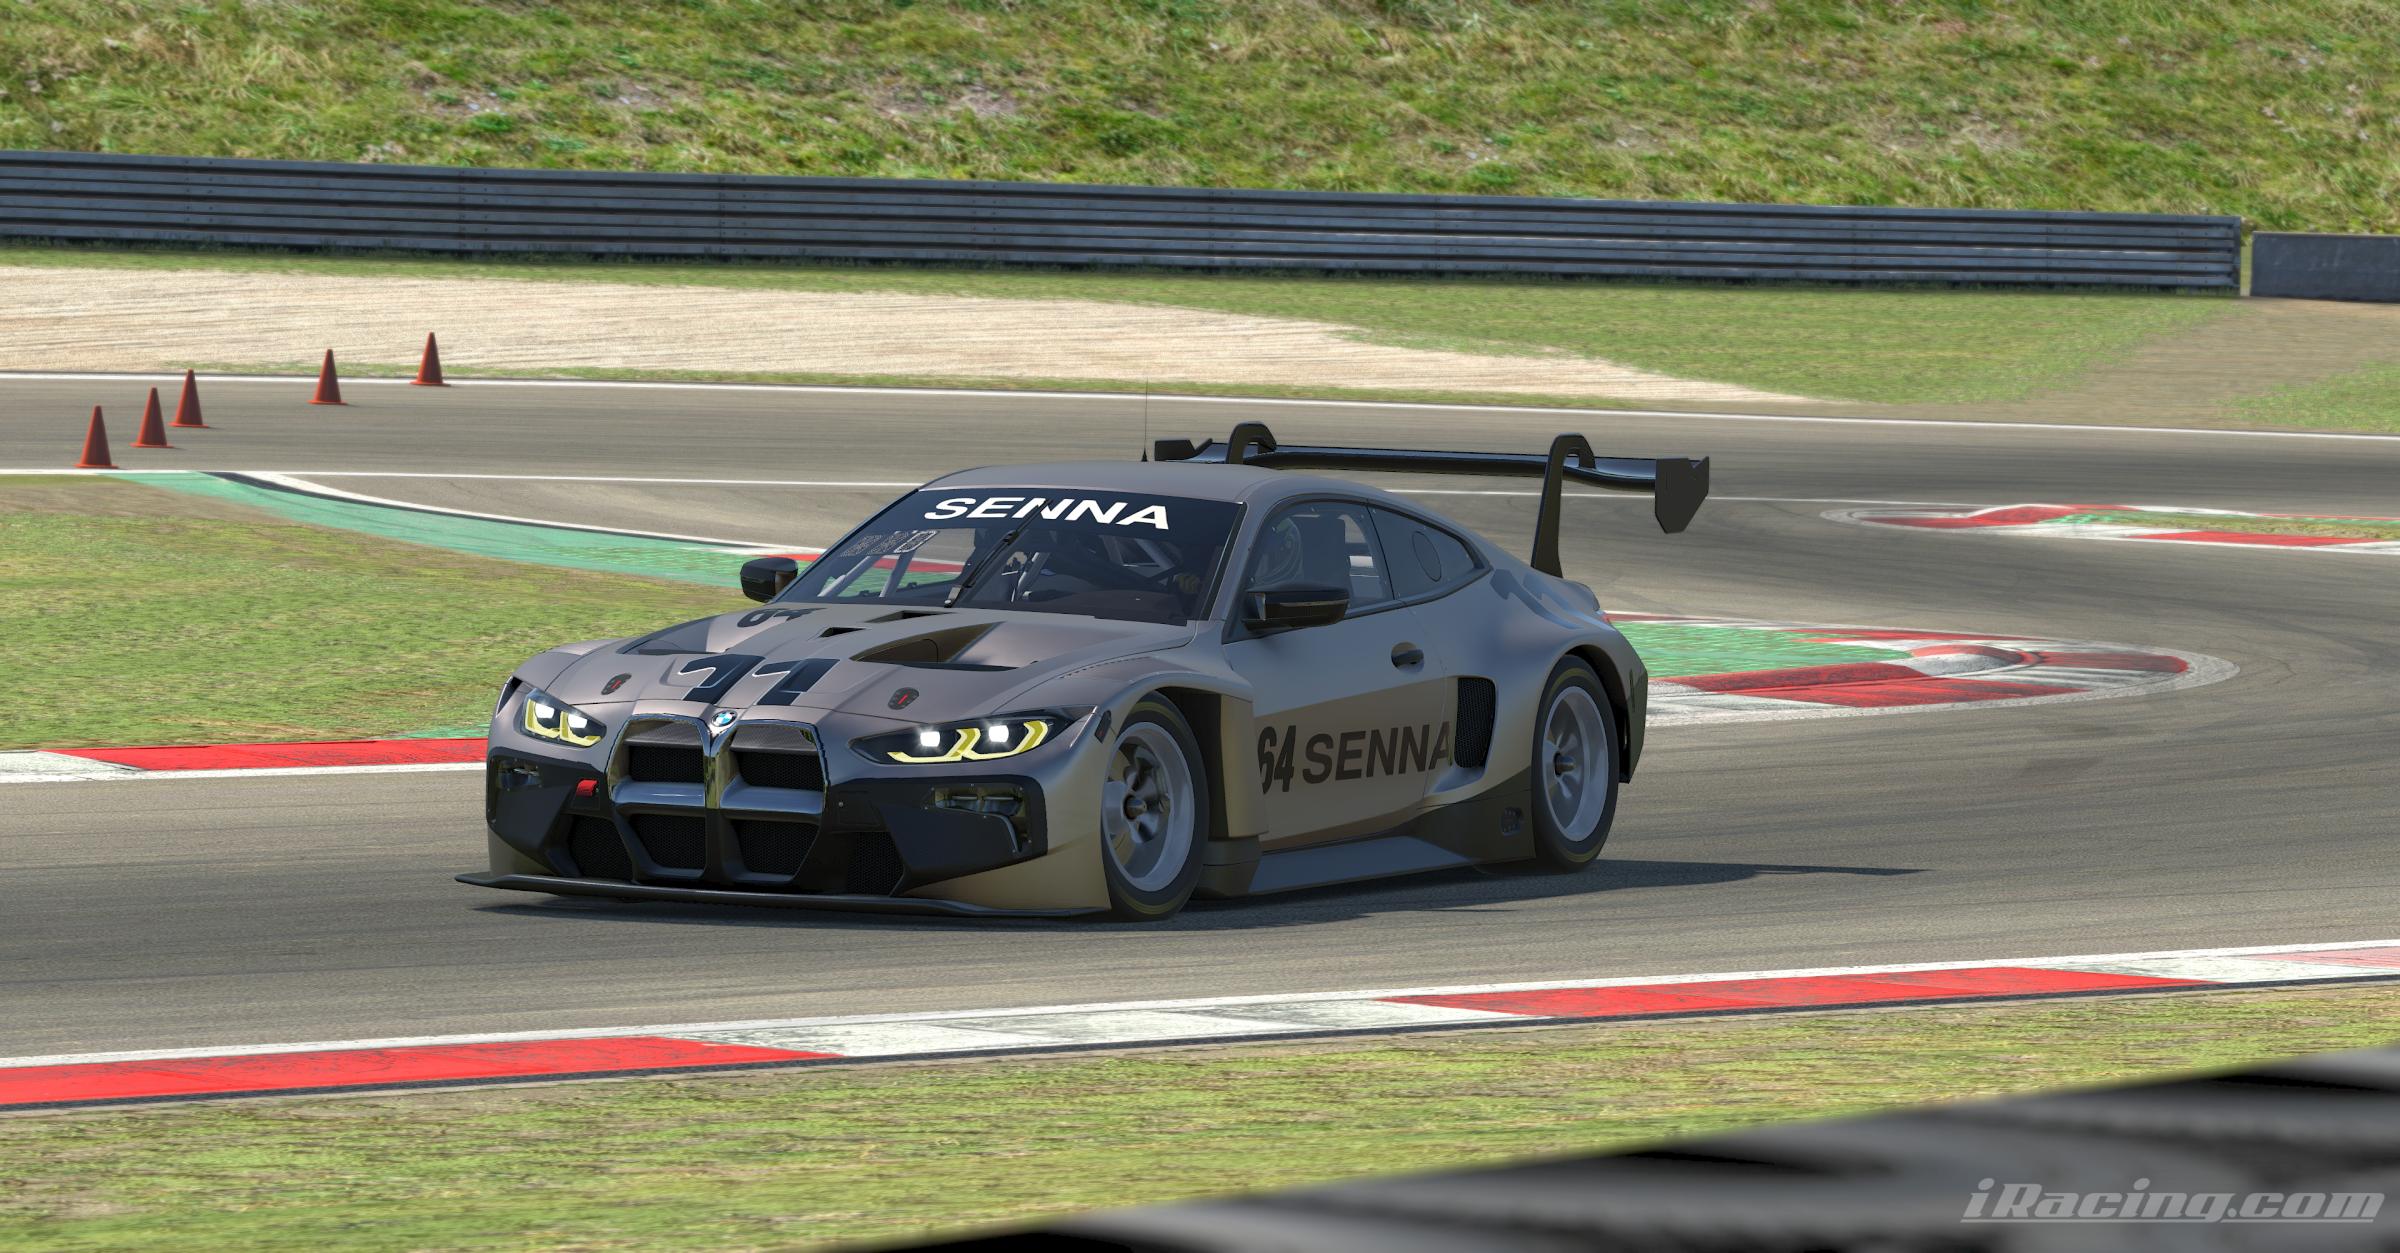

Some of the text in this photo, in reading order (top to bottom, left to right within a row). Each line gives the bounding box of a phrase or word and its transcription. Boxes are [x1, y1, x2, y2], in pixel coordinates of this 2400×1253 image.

[923, 497, 1170, 530] SENNA
[1257, 721, 1453, 794] 64 SENNA
